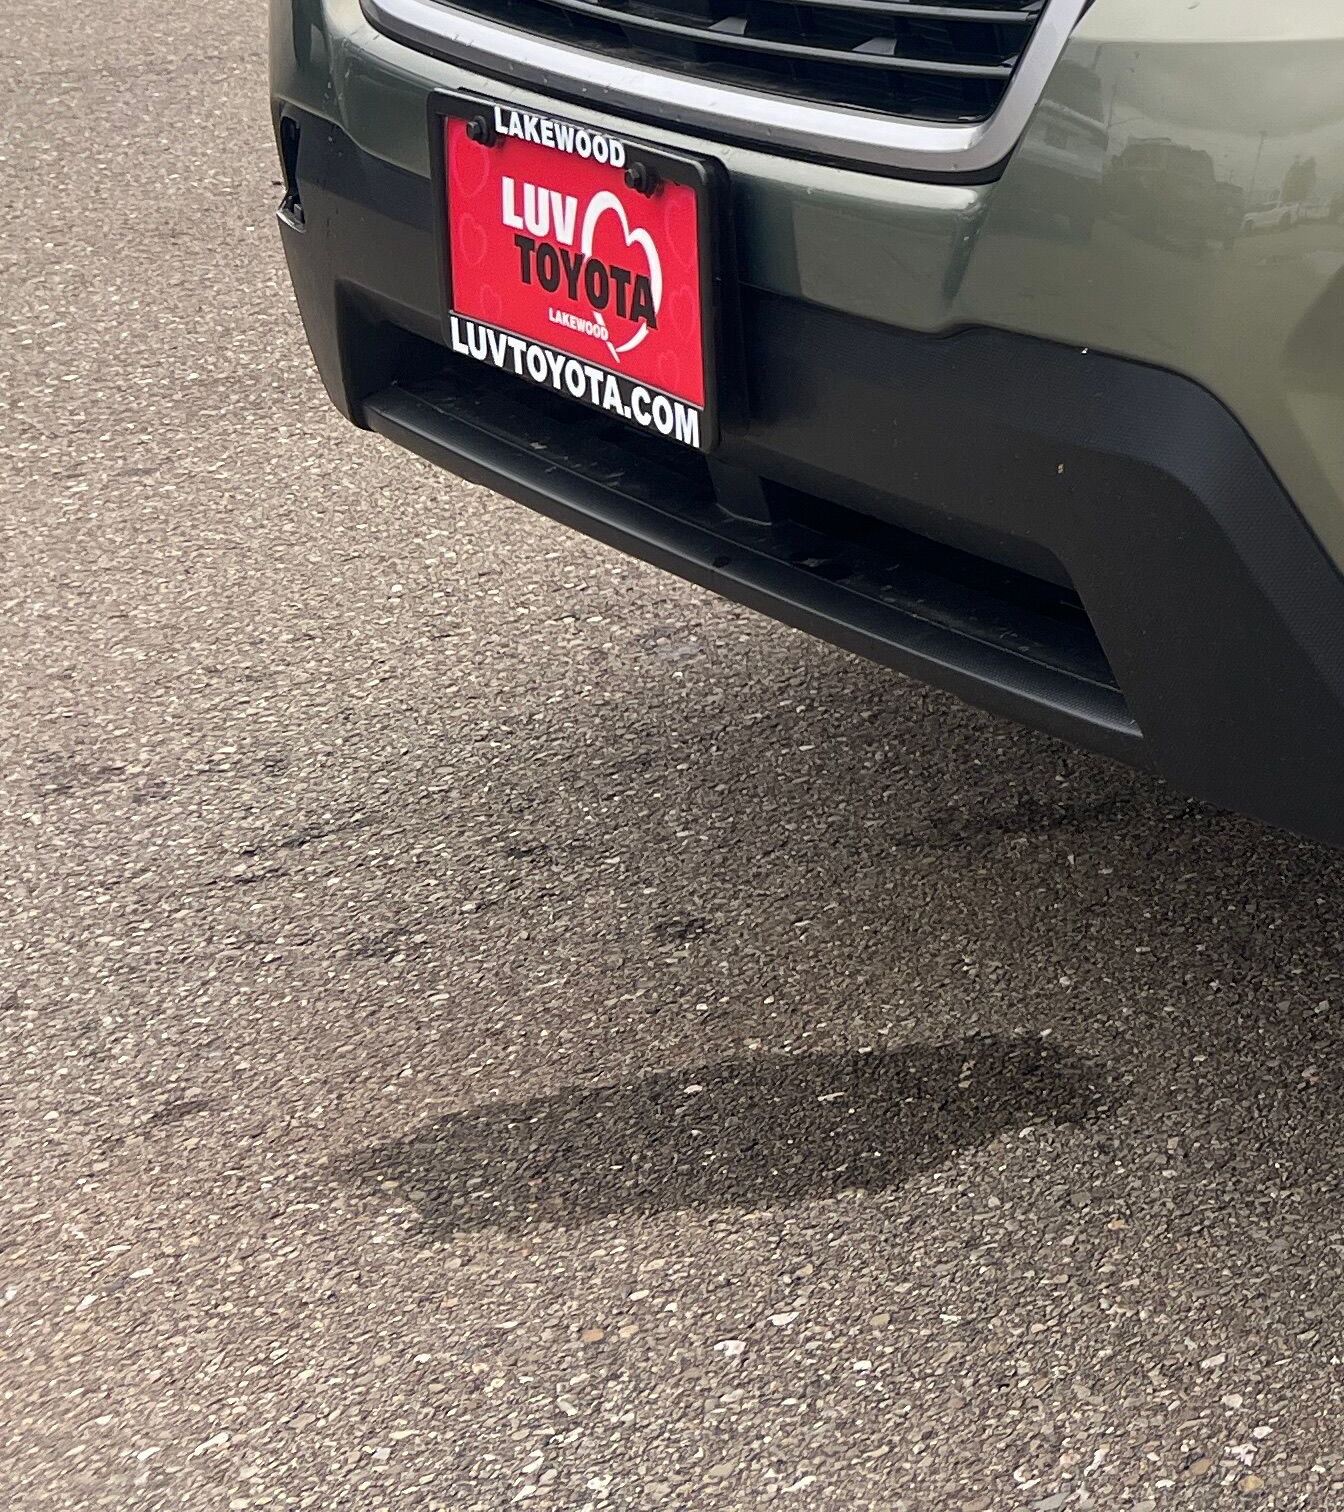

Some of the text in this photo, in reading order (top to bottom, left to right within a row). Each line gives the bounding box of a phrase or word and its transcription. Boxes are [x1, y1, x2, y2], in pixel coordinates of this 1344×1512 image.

[494, 106, 626, 169] LAKEWOOD
[502, 175, 578, 245] LUV
[514, 234, 657, 330] TOYOTA
[548, 307, 609, 341] LAKEWOOD
[450, 316, 700, 448] LUVTOYOTA.COM
